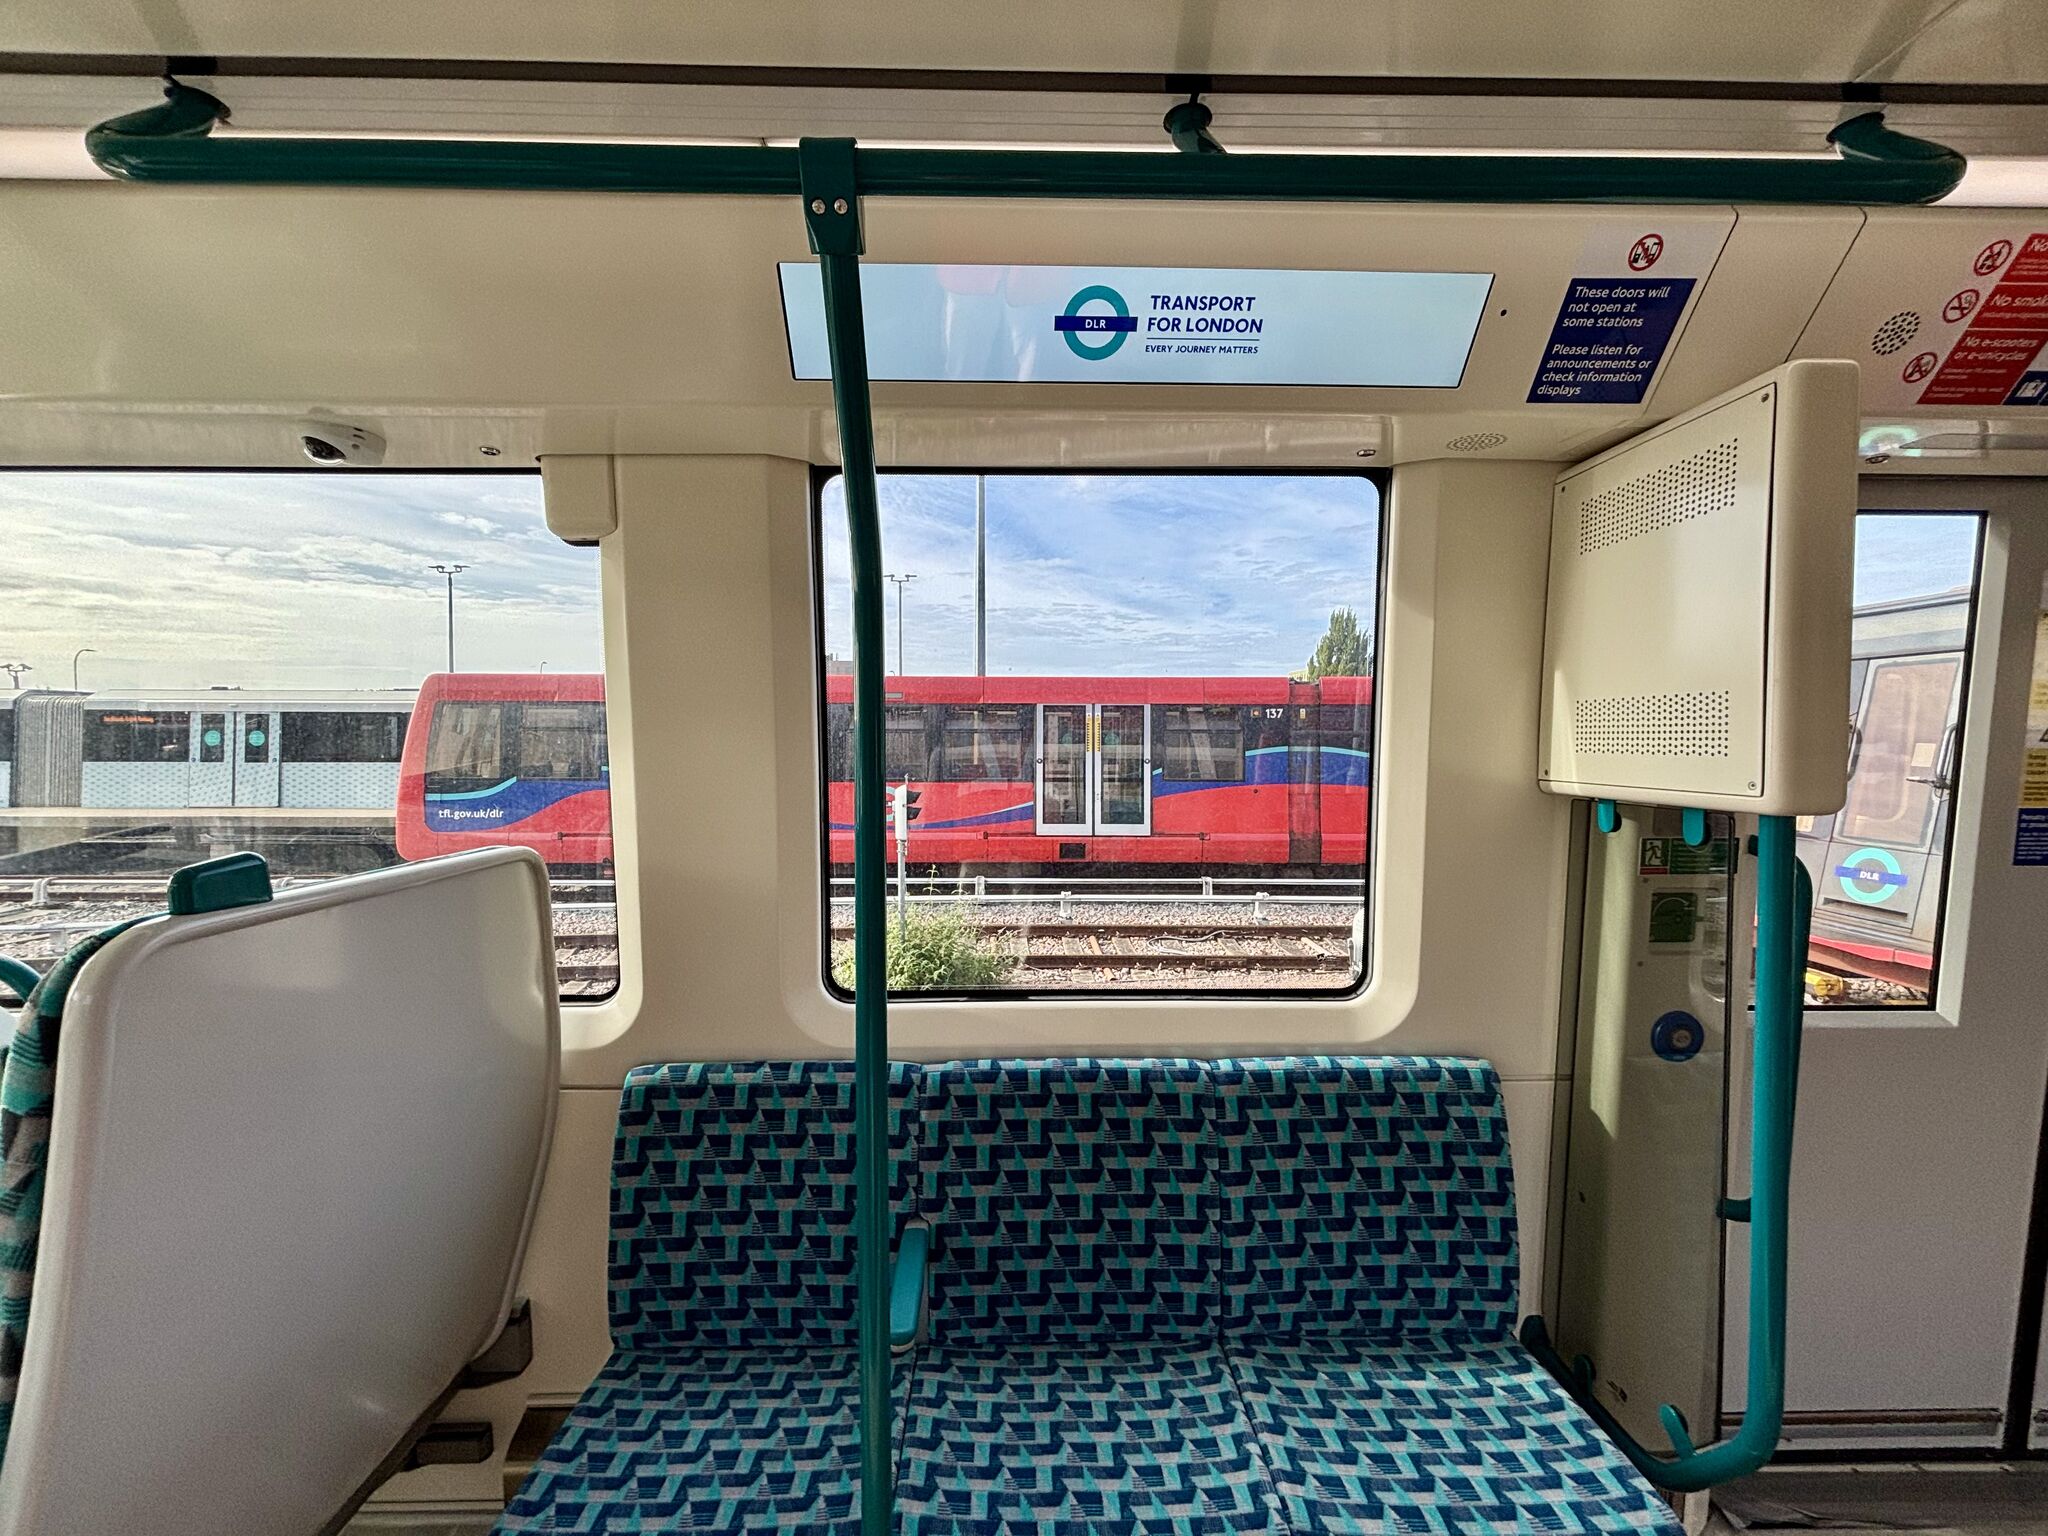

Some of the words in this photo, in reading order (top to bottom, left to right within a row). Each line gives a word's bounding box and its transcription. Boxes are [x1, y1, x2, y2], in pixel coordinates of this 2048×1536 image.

[1574, 286, 1609, 298] These
[1611, 286, 1645, 298] doors
[1648, 286, 1671, 298] will
[1150, 295, 1256, 311] TRANSPORT
[1990, 295, 2012, 306] No
[1567, 303, 1589, 313] not
[1591, 303, 1621, 315] open
[1622, 303, 1637, 313] at
[1085, 319, 1106, 329] DLR
[1147, 317, 1181, 332] FOR
[1185, 317, 1263, 333] LONDON
[1562, 317, 1594, 327] some
[1596, 316, 1644, 327] stations
[1962, 336, 1981, 347] No
[1981, 338, 2039, 348] e-scooters
[1145, 345, 1173, 353] EVERY
[1175, 345, 1217, 353] JOURNEY
[1218, 345, 1259, 354] MATTERS
[1551, 344, 1588, 355] Please
[1590, 344, 1623, 355] listen
[1624, 344, 1643, 355] for
[1546, 358, 1636, 368] announcements
[1638, 359, 1652, 368] or
[1542, 372, 1576, 382] check
[1576, 371, 1642, 382] information
[1536, 385, 1582, 397] displays
[1265, 708, 1283, 719] 137
[438, 808, 504, 820] tfl.gov.uk/dlr
[1859, 870, 1880, 881] DLR
